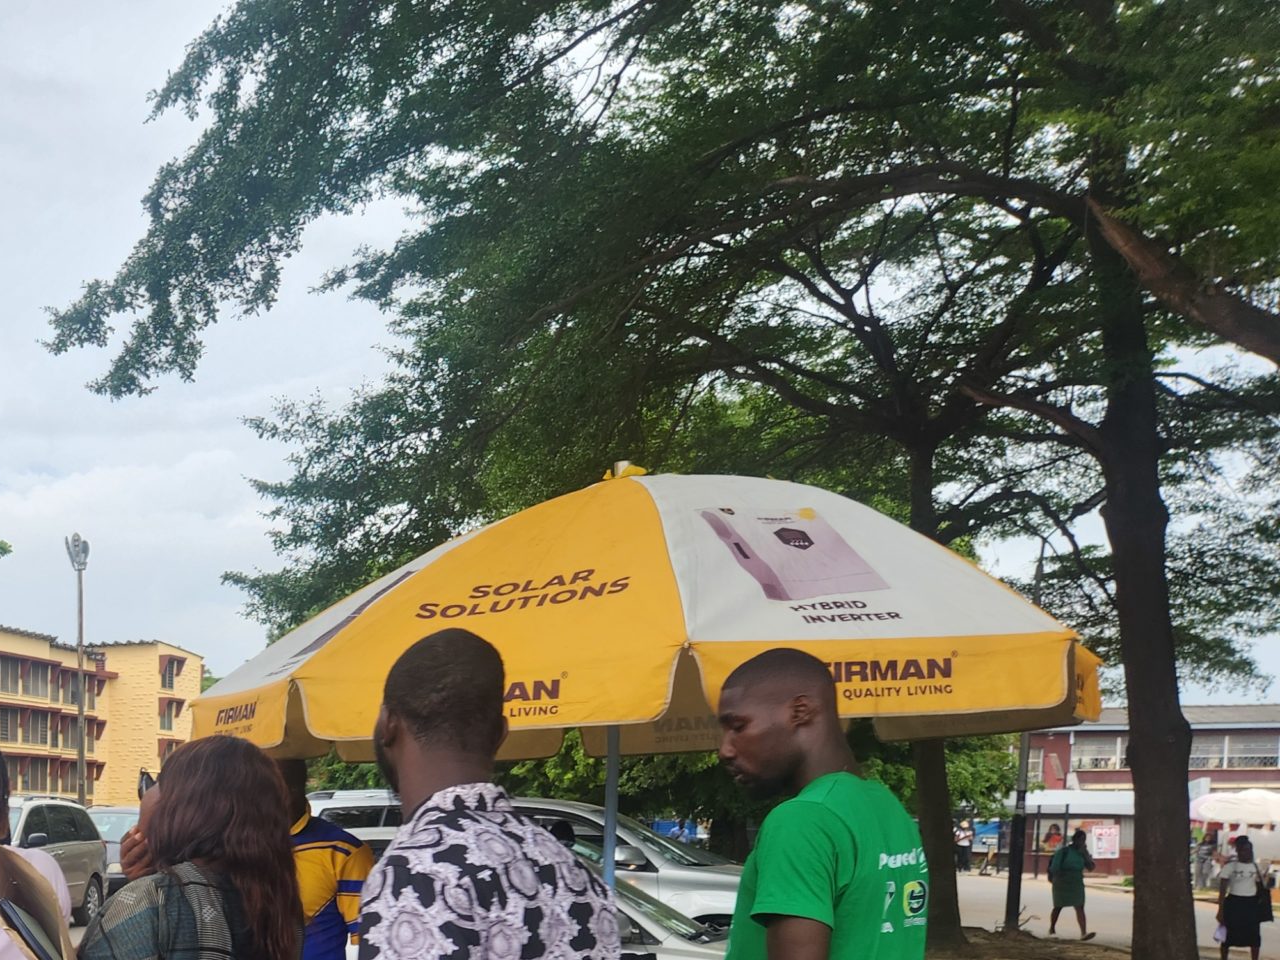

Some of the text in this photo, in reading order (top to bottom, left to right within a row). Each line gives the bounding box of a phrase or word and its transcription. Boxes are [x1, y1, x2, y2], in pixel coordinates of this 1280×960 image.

[468, 569, 595, 599] SOLAR
[415, 576, 631, 620] SOLUTIONS
[789, 600, 867, 612] HYBRID
[802, 611, 902, 624] INVERTER
[824, 657, 952, 683] IRMAN
[843, 684, 953, 700] QUALITY LIVING
[510, 705, 559, 717] LIVING
